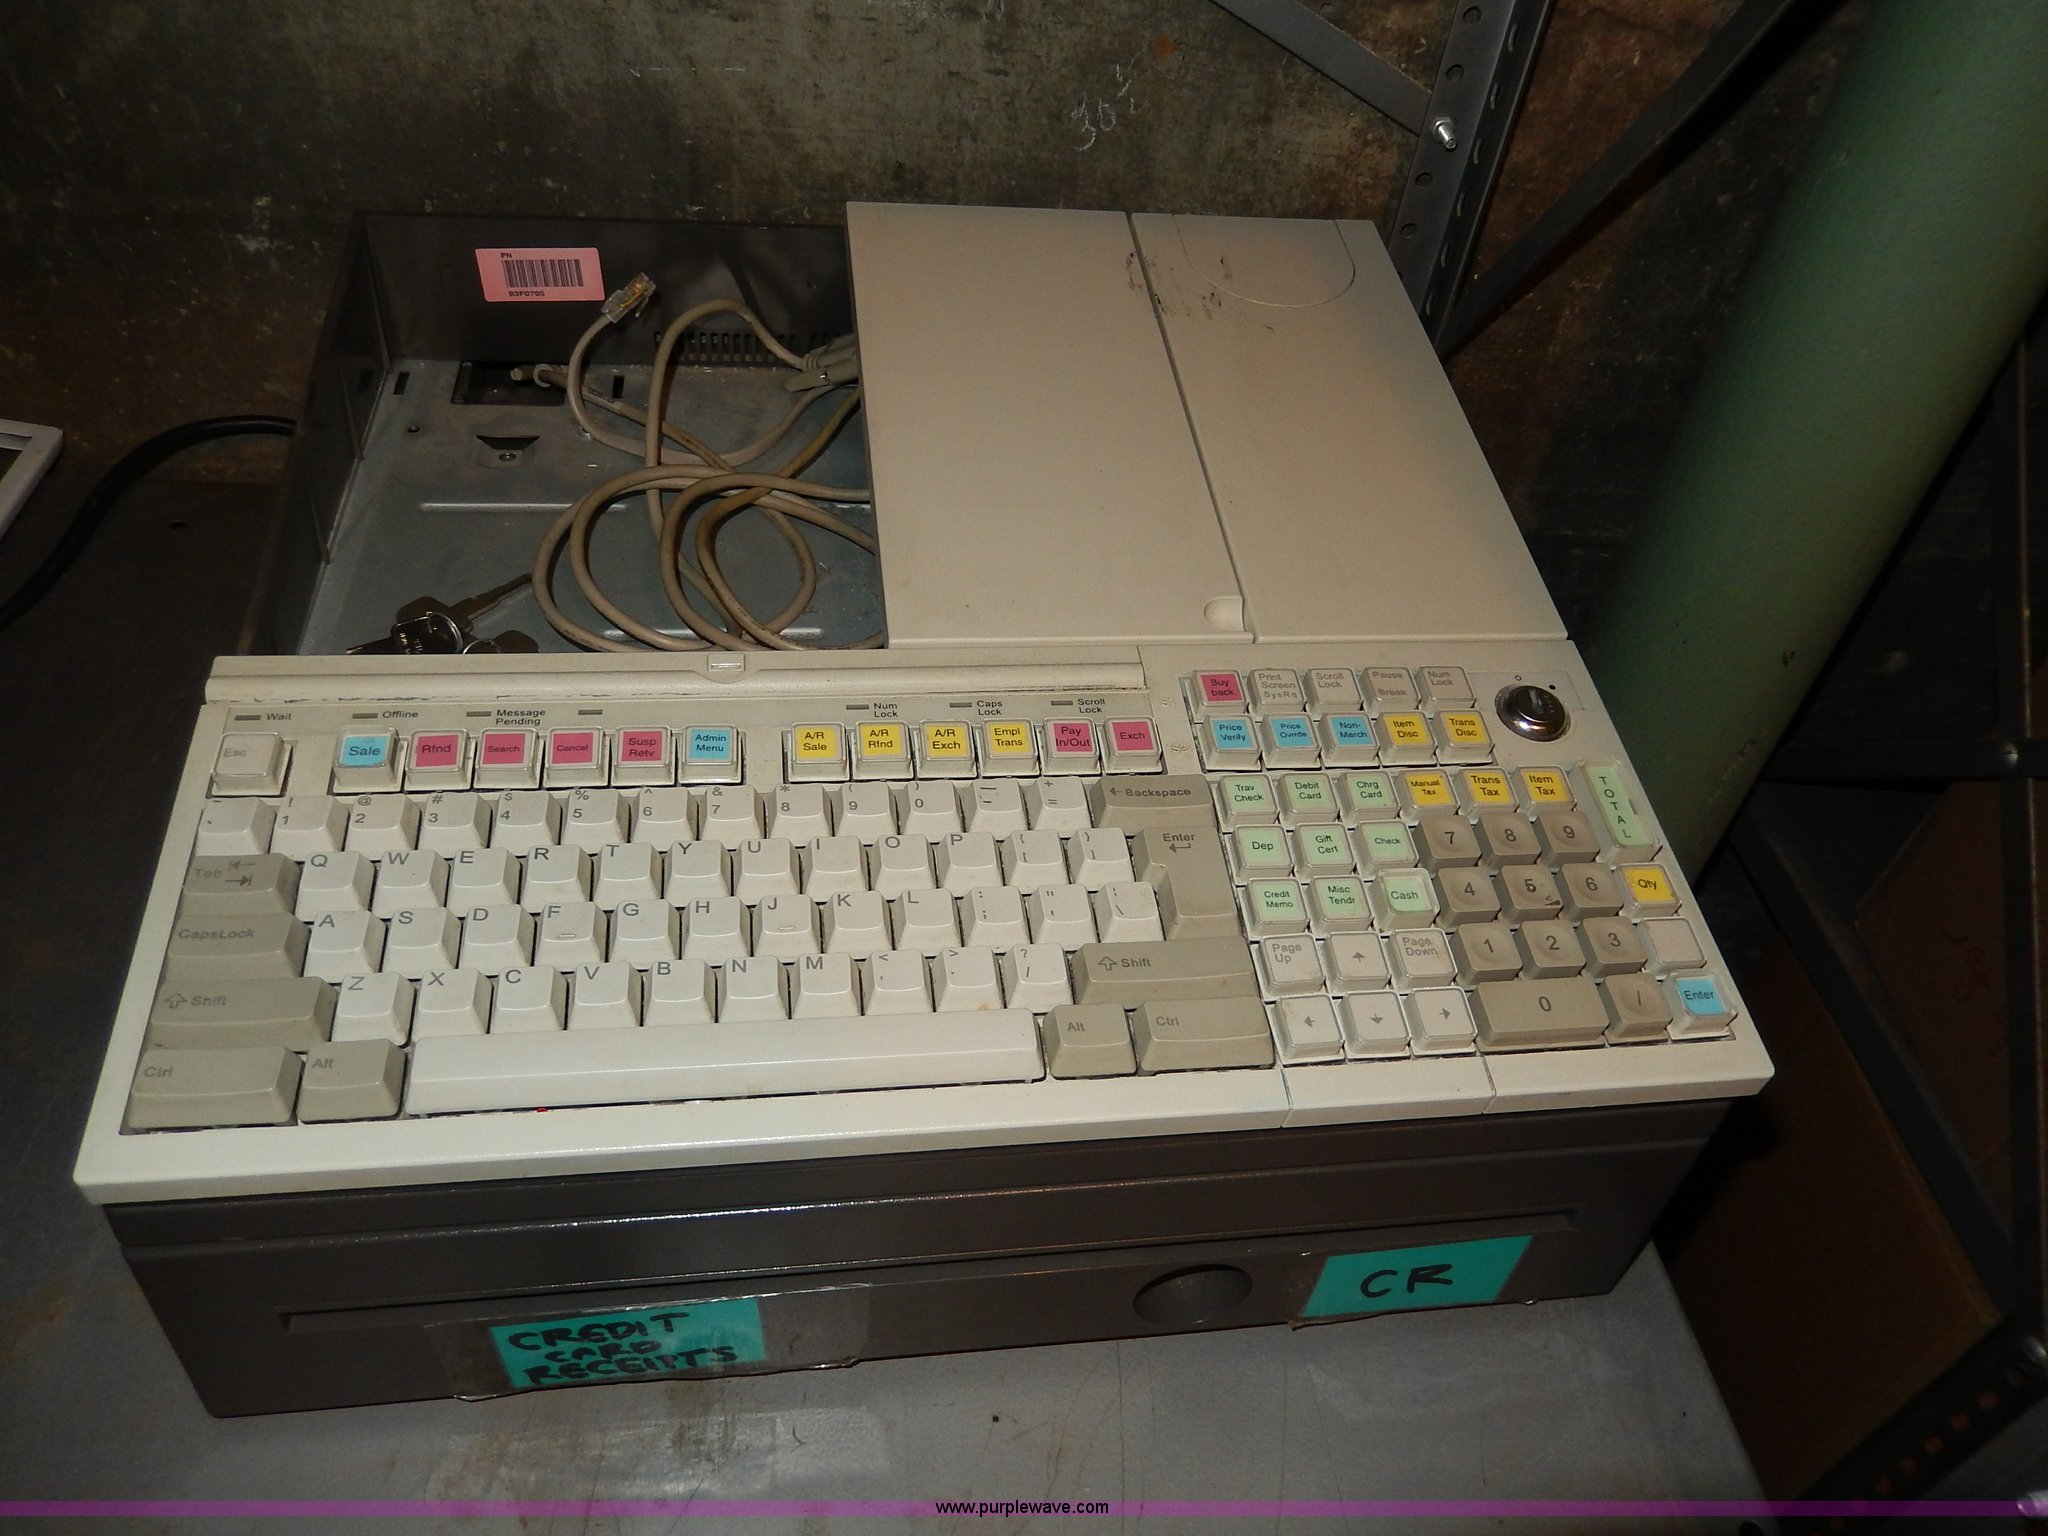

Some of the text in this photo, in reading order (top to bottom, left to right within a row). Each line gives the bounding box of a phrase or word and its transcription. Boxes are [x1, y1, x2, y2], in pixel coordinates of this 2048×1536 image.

[1258, 673, 1281, 681] Print
[1211, 678, 1229, 687] Buy
[1212, 688, 1234, 696] back
[977, 700, 1002, 709] Caps
[267, 713, 291, 721] Wait
[497, 709, 546, 717] Message
[496, 717, 541, 725] Pending
[1393, 720, 1414, 728] Item
[804, 732, 824, 740] A/R
[870, 729, 889, 737] A/R
[935, 729, 955, 737] A/R
[994, 728, 1020, 737] Empl
[1061, 727, 1081, 736] Pay
[1120, 732, 1145, 740] Exch
[1397, 730, 1418, 738] Disc
[695, 734, 726, 742] Admin
[995, 738, 1023, 746] Trans
[1056, 738, 1090, 746] In/Out
[1220, 733, 1246, 742] Verify
[628, 738, 656, 747] Susp
[868, 740, 893, 748] Rfnd
[933, 741, 960, 749] Exch
[223, 748, 247, 757] Esc
[349, 746, 380, 755] Sale
[422, 745, 451, 753] Rfnd
[488, 745, 520, 753] Search
[557, 744, 588, 752] Cancel
[696, 744, 724, 752] Menu
[629, 749, 655, 757] Retv
[1470, 776, 1500, 784] Trans
[1529, 775, 1553, 783] Item
[1356, 781, 1378, 789] Chrg
[1125, 788, 1191, 797] Backspace
[1481, 788, 1500, 796] Tax
[1535, 787, 1555, 795] Tax
[1234, 794, 1264, 802] Check
[781, 803, 790, 812] 8
[849, 801, 857, 810] 9
[915, 799, 924, 808] 0
[572, 808, 582, 818] 5
[643, 807, 652, 816] 6
[711, 805, 720, 814] 7
[355, 814, 365, 823] 2
[429, 813, 437, 822] 3
[501, 810, 510, 820] 4
[282, 816, 288, 824] 1
[1504, 828, 1517, 842] 8
[1564, 825, 1575, 838] 9
[951, 834, 963, 845] P
[1162, 833, 1195, 842] Enter
[1445, 832, 1455, 844] 7
[747, 841, 761, 853] U
[885, 837, 900, 849] O
[1252, 842, 1274, 851] Dep
[607, 845, 619, 857] T
[678, 843, 692, 855] Y
[1318, 846, 1338, 854] Cert
[388, 853, 409, 864] W
[460, 851, 474, 863] E
[534, 848, 549, 860] R
[310, 855, 328, 867] Q
[1464, 882, 1475, 895] 4
[1525, 879, 1536, 892] 5
[1586, 877, 1598, 891] 6
[1638, 879, 1657, 890] Qty
[908, 891, 919, 903] L
[1391, 891, 1418, 900] Cash
[767, 898, 777, 910] J
[837, 894, 851, 907] K
[623, 904, 639, 916] G
[695, 901, 711, 913] H
[473, 909, 488, 920] D
[547, 906, 561, 918] F
[319, 915, 335, 928] A
[398, 911, 414, 924] S
[179, 929, 254, 939] CapsLock
[1402, 937, 1431, 947] Page
[1546, 936, 1560, 950] 2
[1607, 932, 1621, 947] 3
[1272, 943, 1302, 953] Page
[1484, 938, 1494, 952] 1
[1405, 947, 1438, 956] Down
[1121, 958, 1151, 967] Shift
[1275, 954, 1291, 963] Up
[732, 960, 747, 972] N
[806, 957, 824, 970] M
[584, 966, 600, 980] V
[657, 962, 671, 975] B
[428, 972, 444, 986] X
[505, 970, 522, 983] C
[348, 977, 365, 990] Z
[1684, 990, 1714, 1000] Enter
[191, 995, 227, 1006] Shift
[1539, 997, 1551, 1011] 0
[1155, 1017, 1179, 1026] Ctrl
[1067, 1022, 1085, 1032] Alt
[312, 1058, 333, 1069] Alt
[144, 1067, 172, 1078] Ctrl
[1360, 1263, 1453, 1298] CR
[524, 1346, 738, 1385] RECEIPTS
